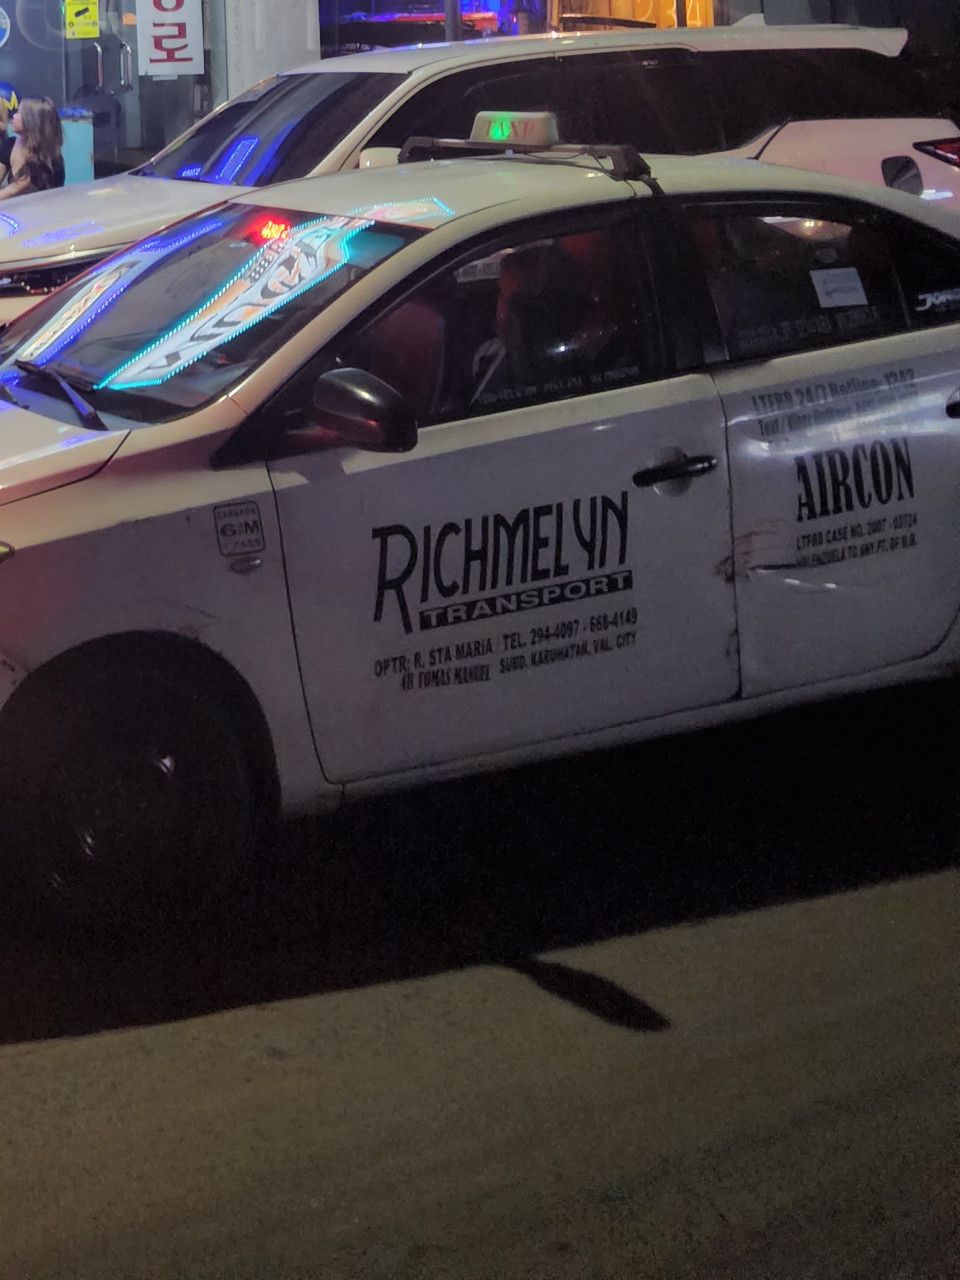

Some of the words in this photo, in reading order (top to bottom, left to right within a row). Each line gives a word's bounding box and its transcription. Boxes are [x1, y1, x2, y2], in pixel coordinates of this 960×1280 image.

[794, 436, 915, 522] AIRCON
[371, 490, 628, 635] RICHMELYN
[423, 571, 631, 628] TRANSPORT
[428, 644, 452, 667] STA
[455, 637, 494, 660] MARIA
